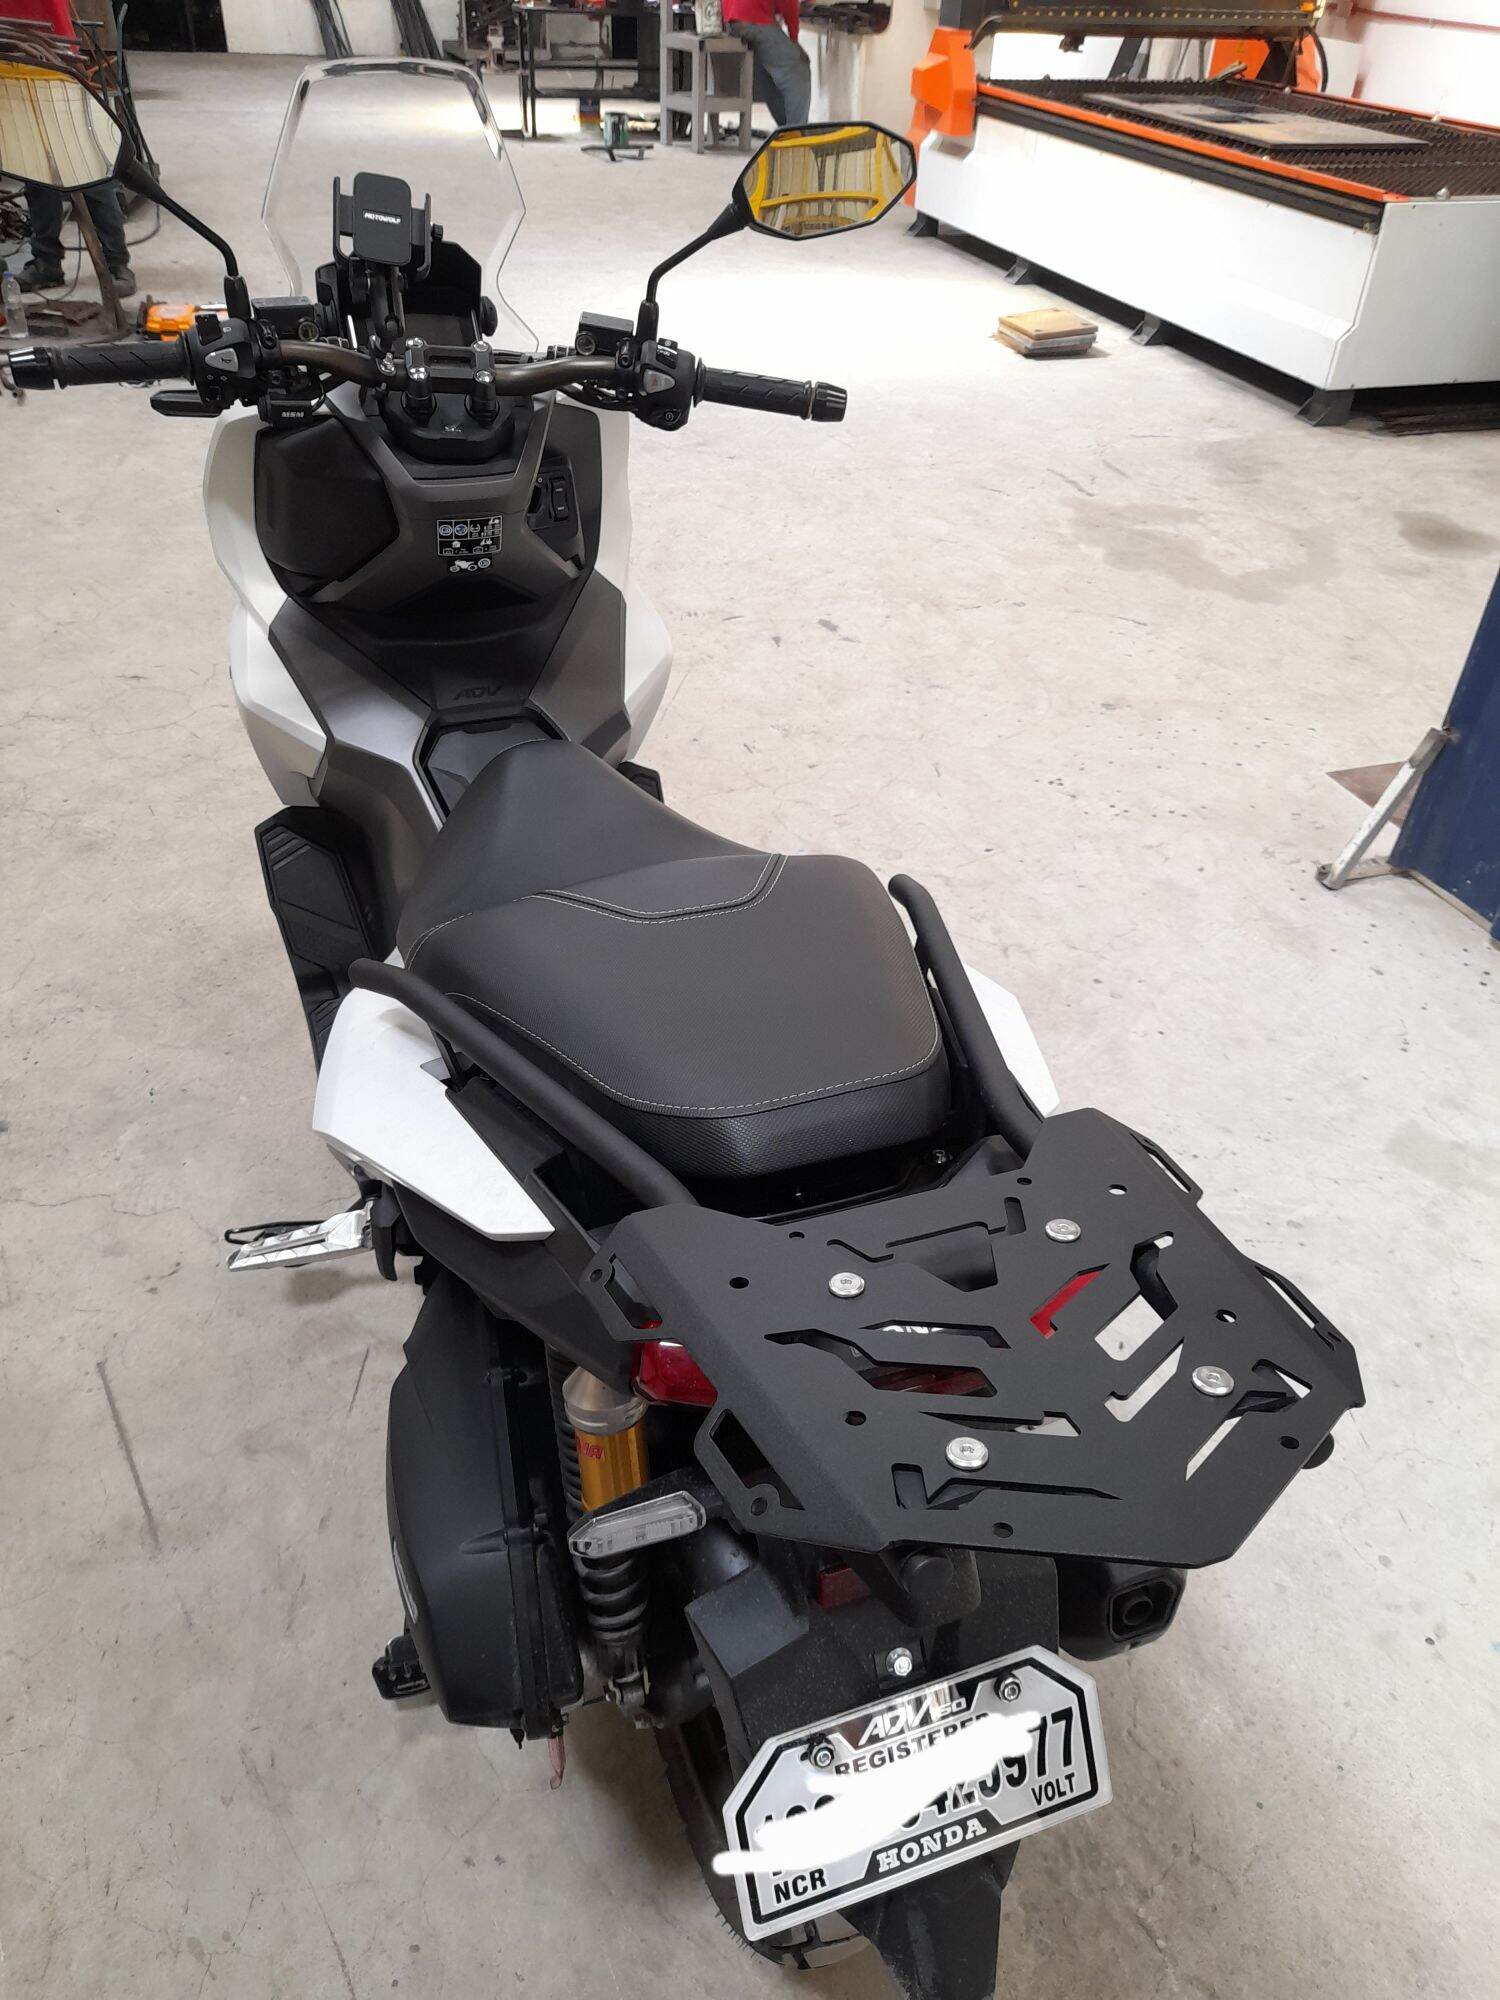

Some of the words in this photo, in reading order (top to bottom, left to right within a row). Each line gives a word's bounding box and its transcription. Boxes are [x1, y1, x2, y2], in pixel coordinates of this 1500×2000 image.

[834, 1712, 989, 1777] REGISTER
[1031, 1772, 1075, 1806] VOLT
[876, 1818, 987, 1873] HONDA
[773, 1868, 827, 1905] NCR
